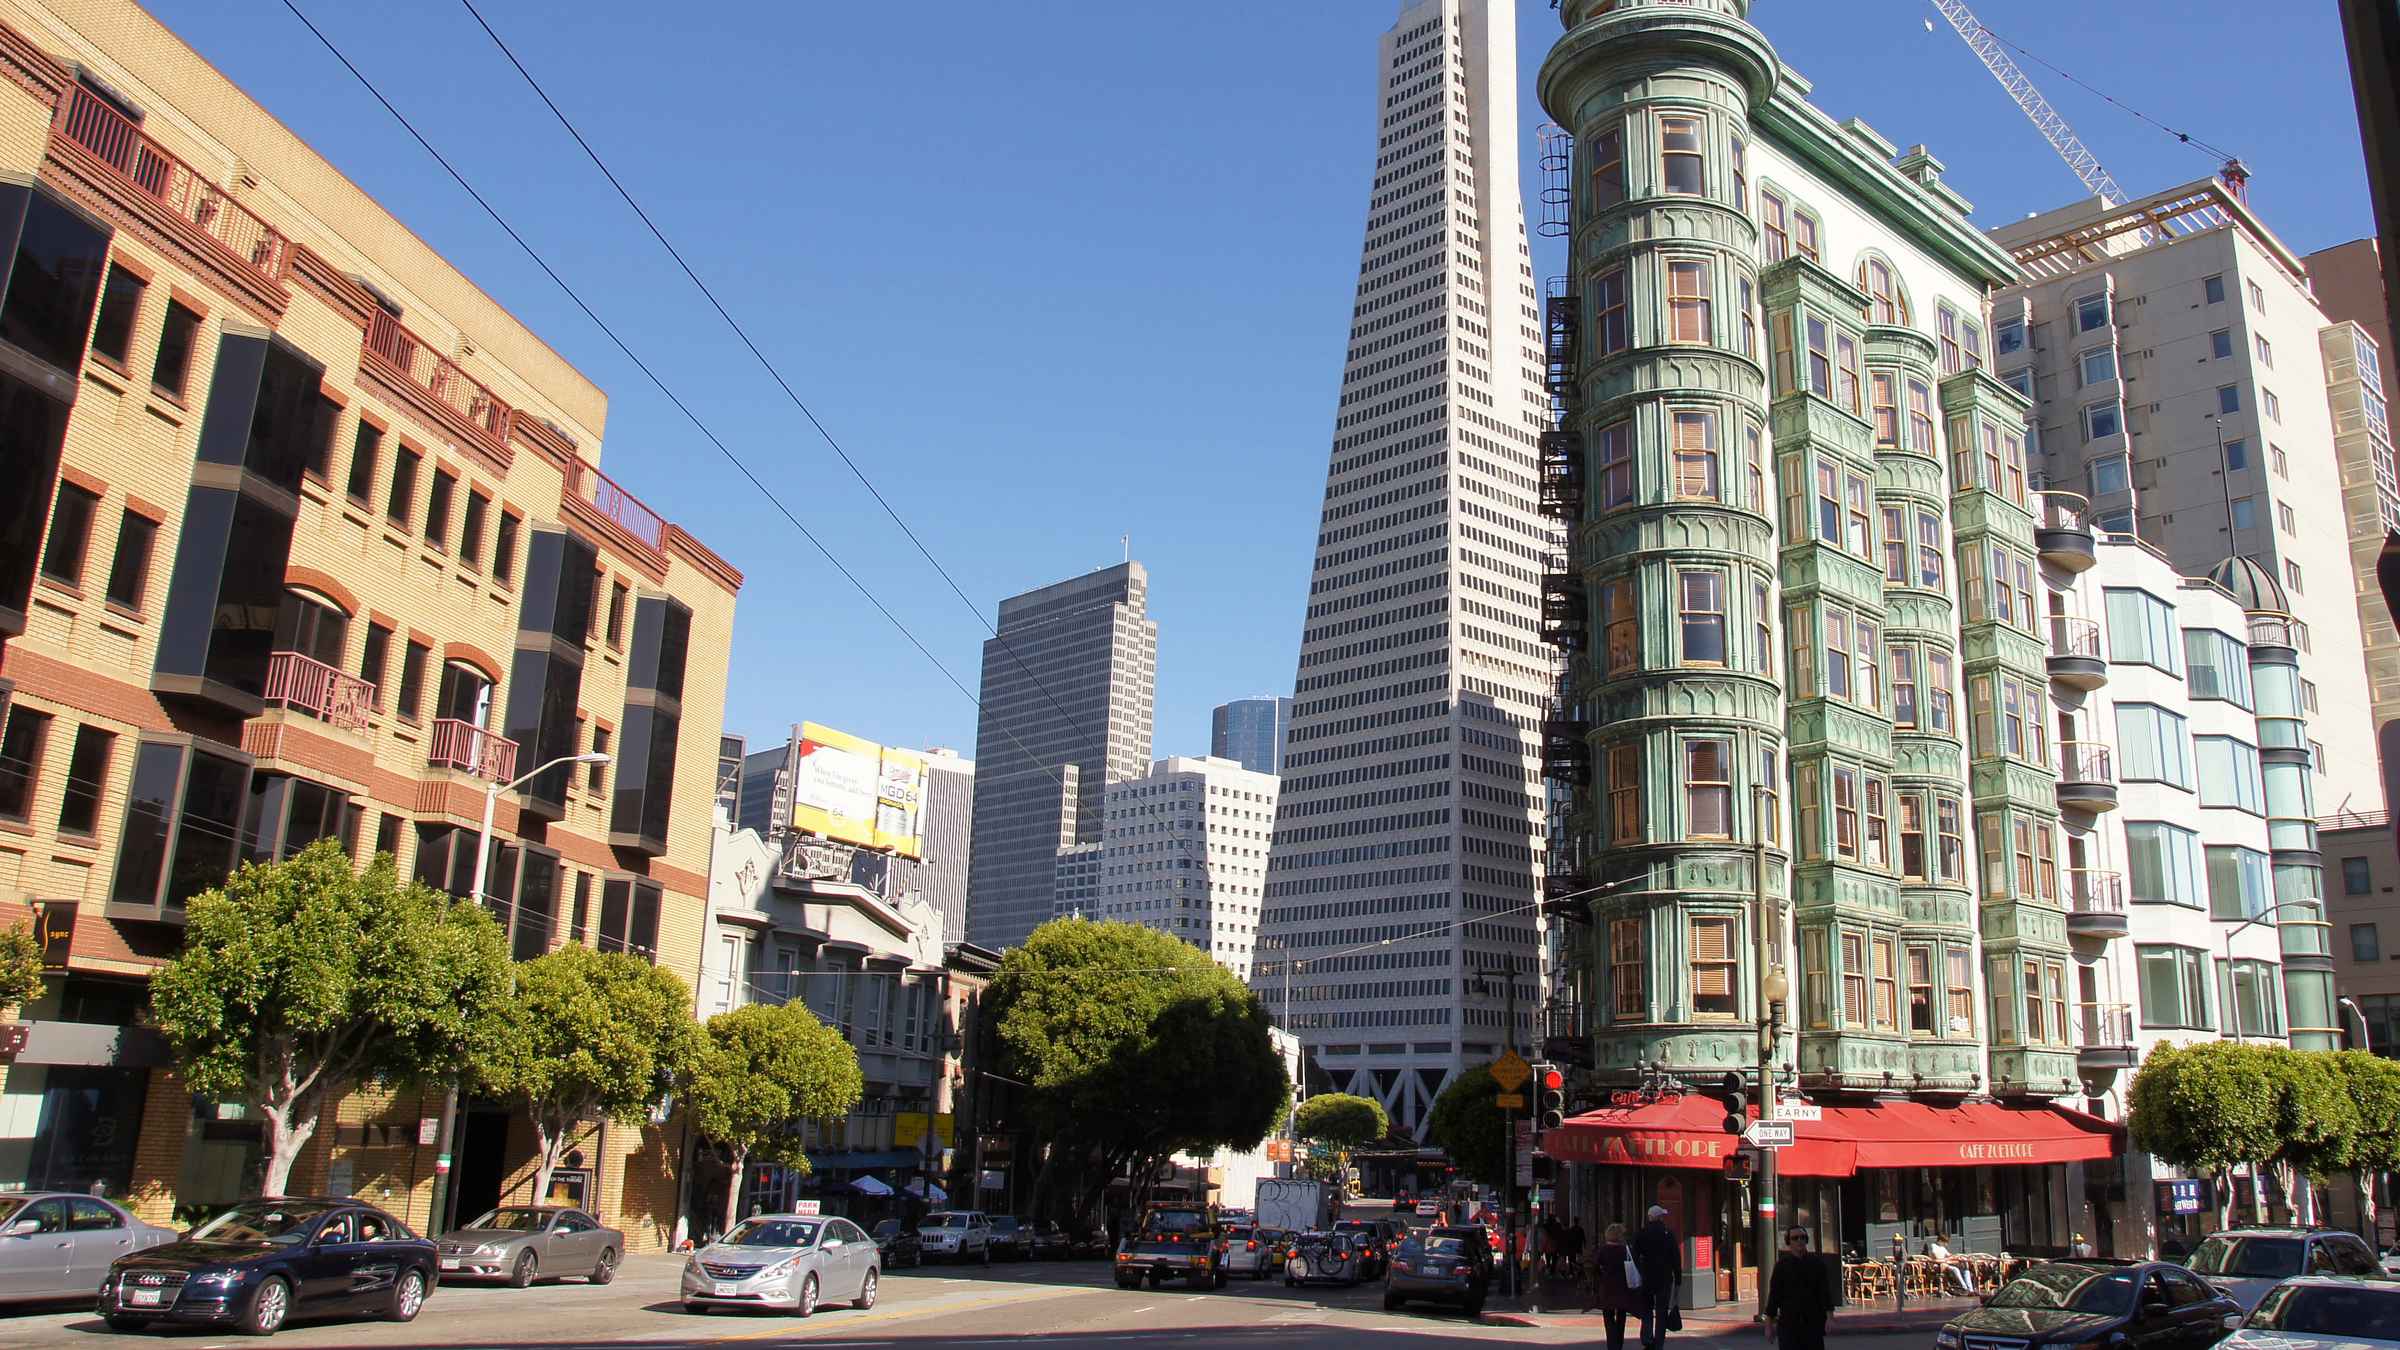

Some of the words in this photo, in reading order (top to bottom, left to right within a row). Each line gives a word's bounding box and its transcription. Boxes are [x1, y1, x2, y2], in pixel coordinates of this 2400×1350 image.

[880, 785, 905, 800] MGD
[1776, 1108, 1819, 1118] EARNY
[1759, 1128, 1773, 1138] ONE
[1774, 1128, 1788, 1138] WAY
[1959, 1143, 1985, 1159] CAFE
[1987, 1143, 2033, 1158] ZOETROPE
